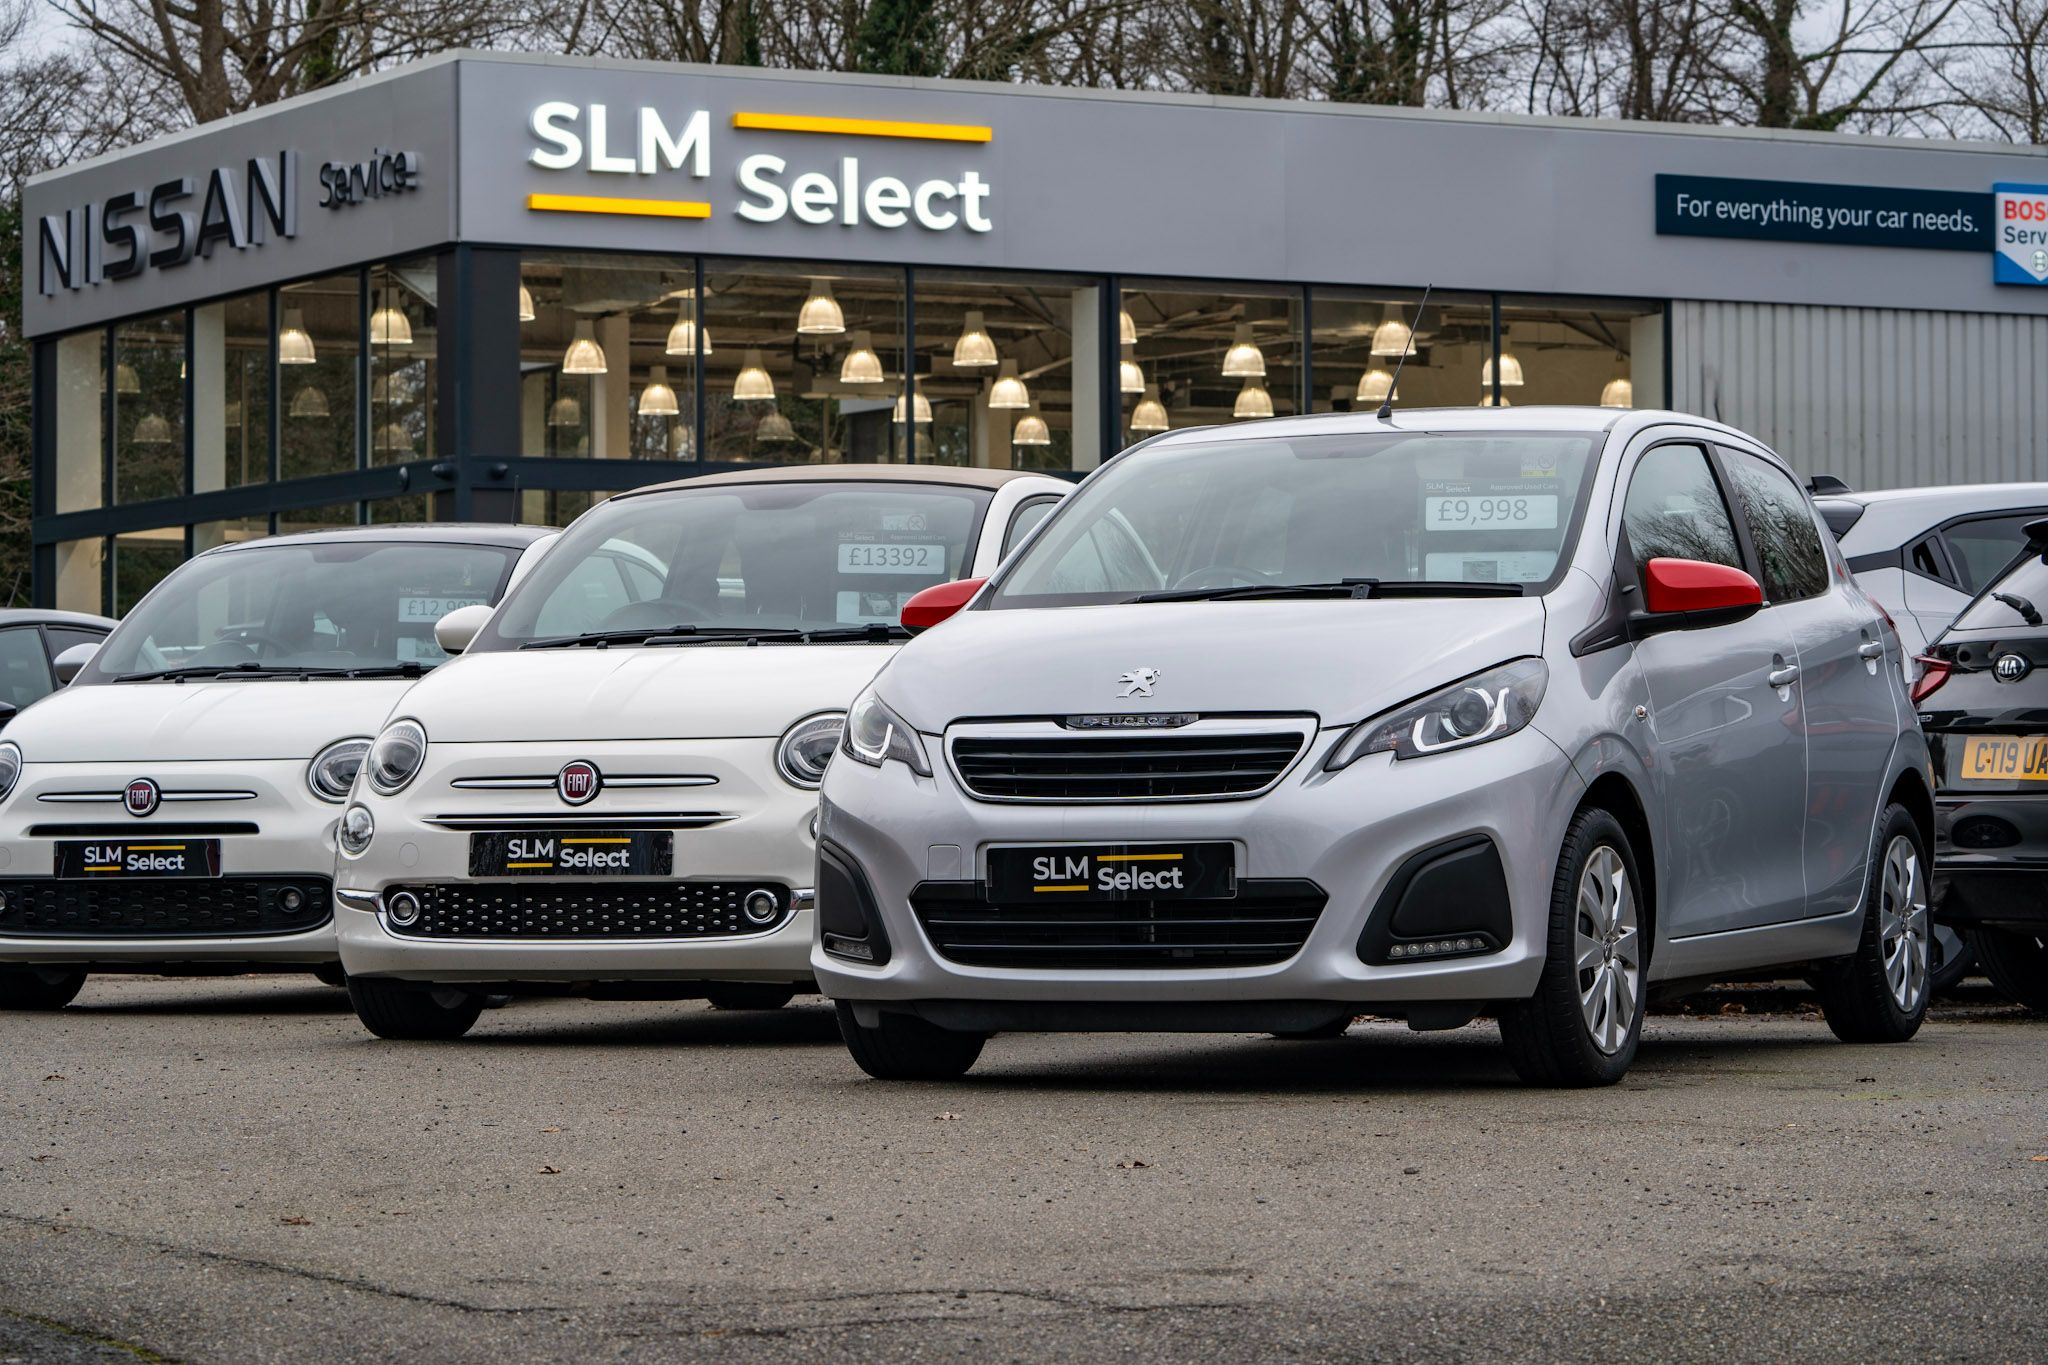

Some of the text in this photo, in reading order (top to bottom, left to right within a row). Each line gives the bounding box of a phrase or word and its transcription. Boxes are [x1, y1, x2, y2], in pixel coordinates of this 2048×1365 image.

[529, 102, 711, 177] SLM
[319, 147, 418, 209] Service
[734, 154, 992, 232] Select
[1677, 193, 1979, 232] For everything your car needs.
[2004, 200, 2048, 221] BOS
[39, 150, 297, 296] NISSAN
[1446, 485, 1471, 493] Select
[1438, 499, 1528, 525] £9,998
[848, 547, 928, 567] £13392
[1998, 660, 2018, 675] KIA
[1090, 716, 1171, 727] PEUGEOT
[1975, 742, 2019, 773] CT19
[567, 773, 589, 792] FIAT
[131, 789, 150, 805] FIAT
[84, 846, 122, 863] SLM
[507, 839, 554, 859] SLM
[559, 847, 630, 868] Select
[126, 853, 185, 871] Select
[1033, 856, 1089, 880] SLM
[1097, 865, 1184, 891] Select
